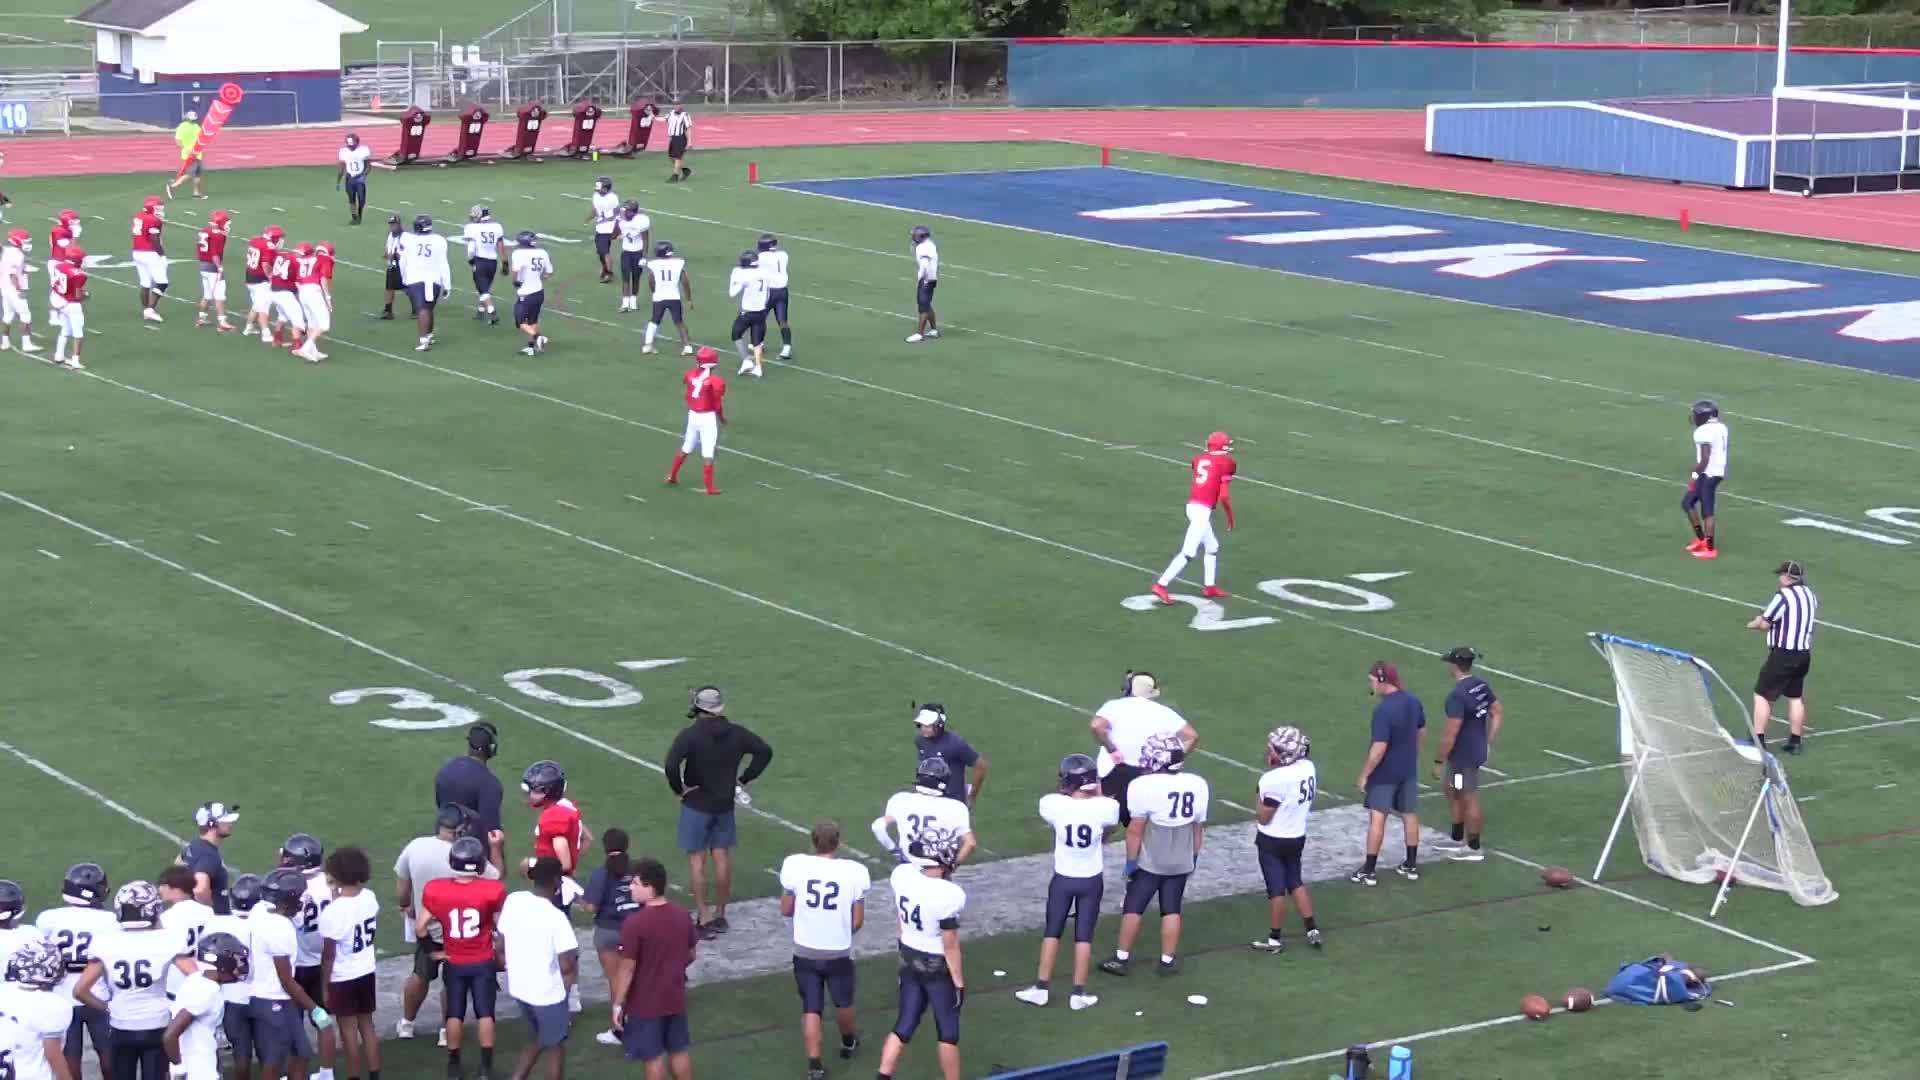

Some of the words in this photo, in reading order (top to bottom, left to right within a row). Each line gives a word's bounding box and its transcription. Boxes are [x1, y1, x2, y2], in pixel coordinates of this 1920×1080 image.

[416, 243, 432, 258] 75
[480, 231, 495, 244] 59
[530, 257, 544, 272] 55
[660, 270, 673, 281] 11
[1194, 460, 1210, 484] 5
[1300, 777, 1315, 804] 58
[1167, 792, 1194, 818] 78
[1064, 824, 1093, 849] 19
[806, 880, 839, 911] 52
[449, 908, 480, 939] 12
[899, 896, 922, 931] 54
[57, 929, 93, 964] 22
[353, 918, 376, 954] 85
[114, 960, 152, 989] 36
